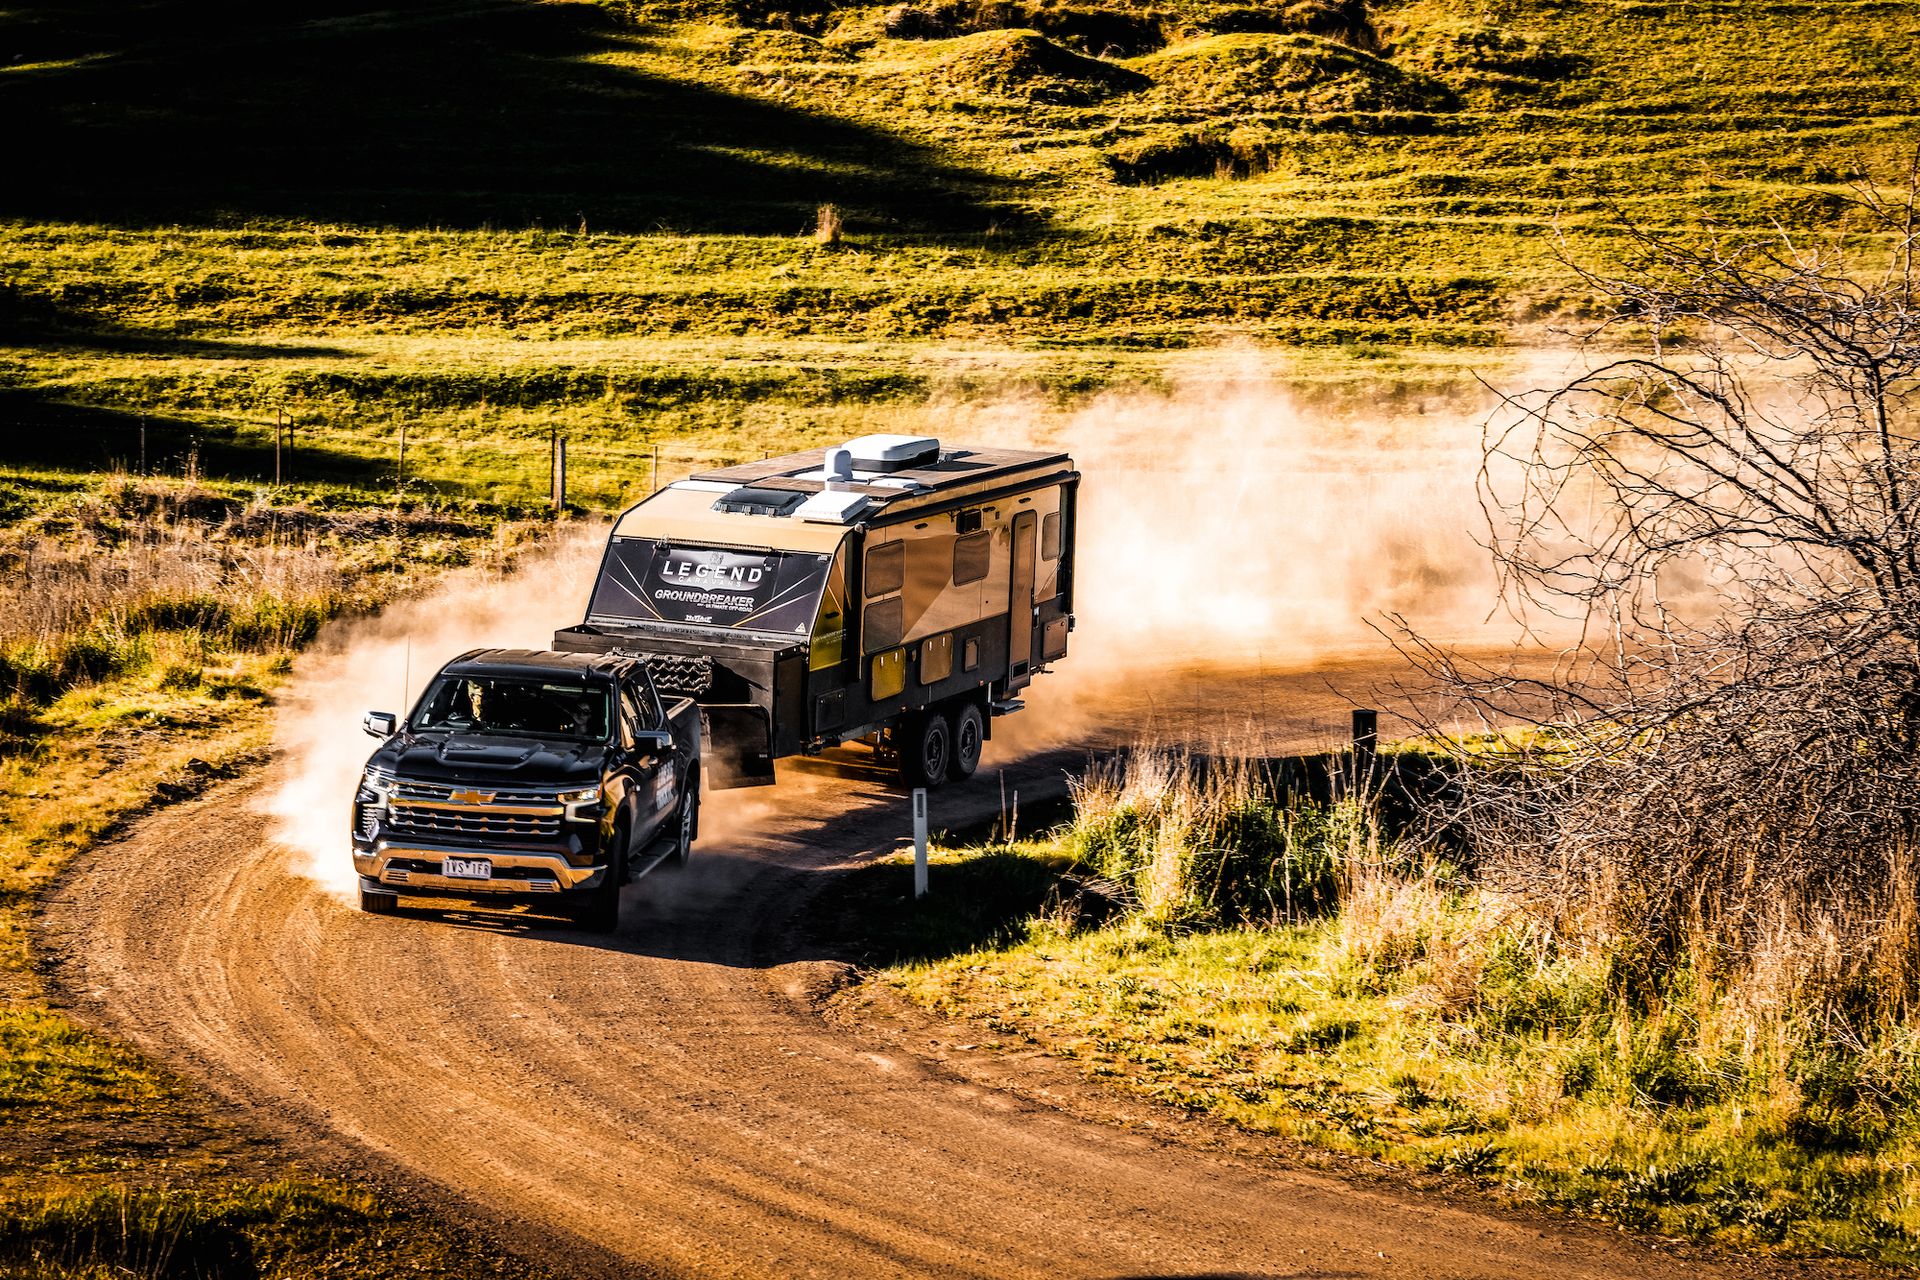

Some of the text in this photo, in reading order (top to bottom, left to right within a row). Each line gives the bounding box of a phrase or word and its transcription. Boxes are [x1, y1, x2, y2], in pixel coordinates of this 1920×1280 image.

[662, 560, 763, 583] LEGEND
[678, 576, 742, 588] CARAVANS
[654, 589, 755, 608] GROUNDBREAKER
